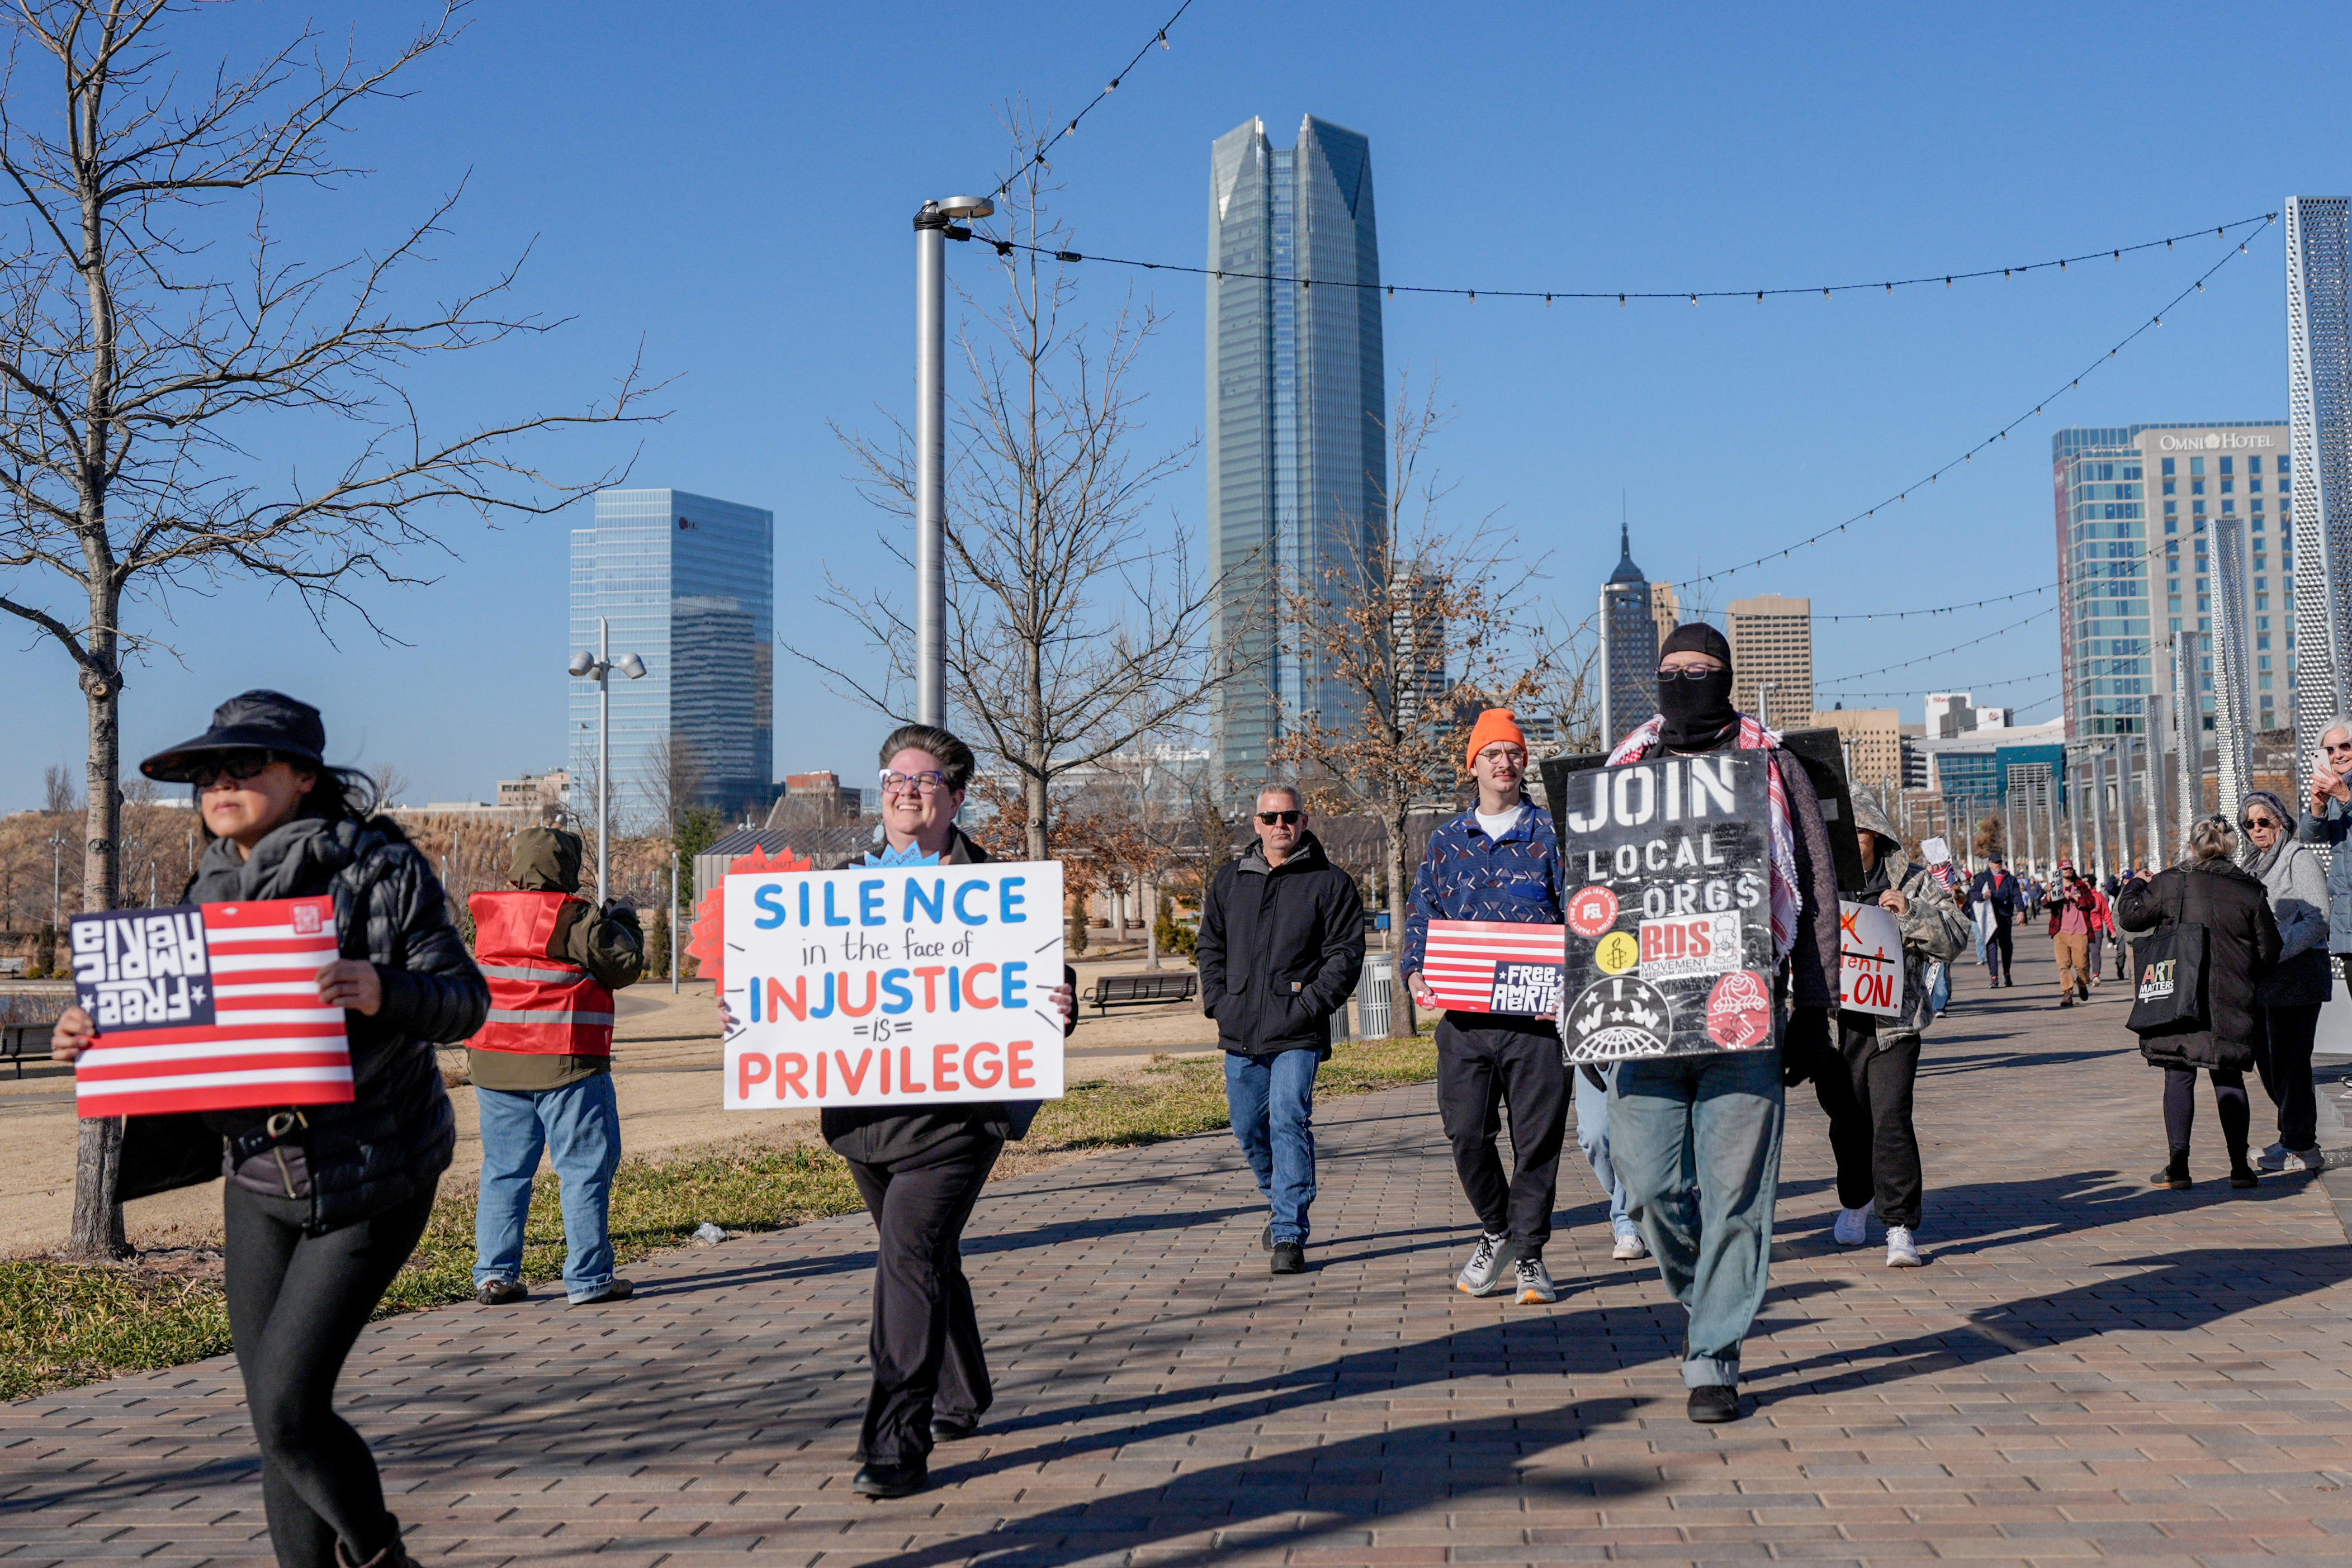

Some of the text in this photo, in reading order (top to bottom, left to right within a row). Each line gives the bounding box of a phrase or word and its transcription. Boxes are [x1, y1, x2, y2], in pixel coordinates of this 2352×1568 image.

[2160, 433, 2275, 451] OMNI HOTEL
[1568, 754, 1735, 833] JOIN
[731, 861, 793, 872] SPEAK OUT
[1588, 833, 1725, 882] LOCAL
[1643, 877, 1759, 918] ORGS
[2051, 878, 2062, 887] OUT
[754, 877, 1027, 930] SILENCE
[1583, 903, 1603, 920] PSL
[802, 927, 974, 967] in the face of
[1641, 920, 1711, 962] BDS
[1641, 958, 1709, 972] MOVEMENT
[1641, 969, 1675, 978] FREEDOM
[1706, 963, 1740, 972] EQUALITY
[2141, 959, 2176, 984] ART
[750, 961, 1028, 1023] INJUSTICE
[2139, 979, 2174, 993] MATTERS
[739, 1040, 1036, 1100] PRIVILEGE
